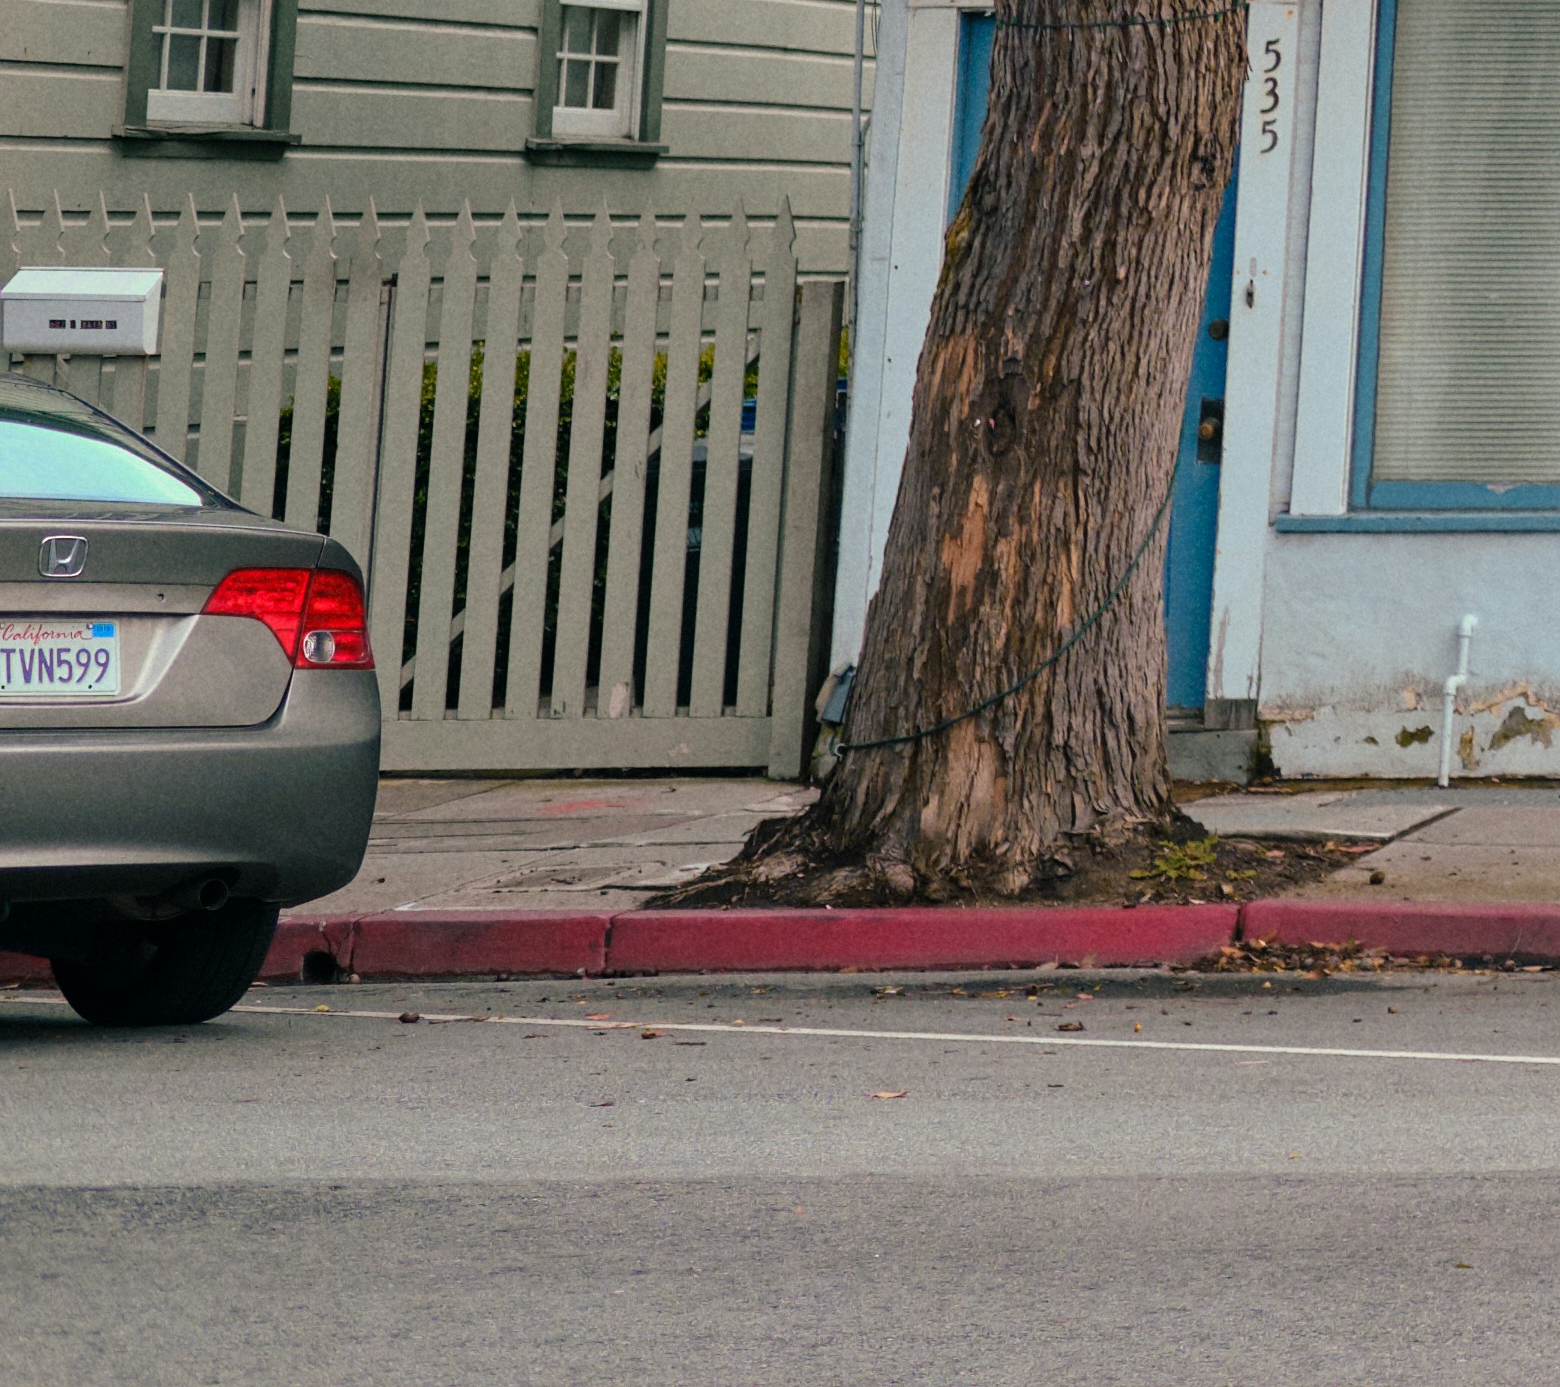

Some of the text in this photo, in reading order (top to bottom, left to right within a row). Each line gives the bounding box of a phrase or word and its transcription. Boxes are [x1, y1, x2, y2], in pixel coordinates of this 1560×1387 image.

[1259, 38, 1282, 154] 535
[2, 623, 92, 645] California
[0, 648, 110, 684] TVN599
